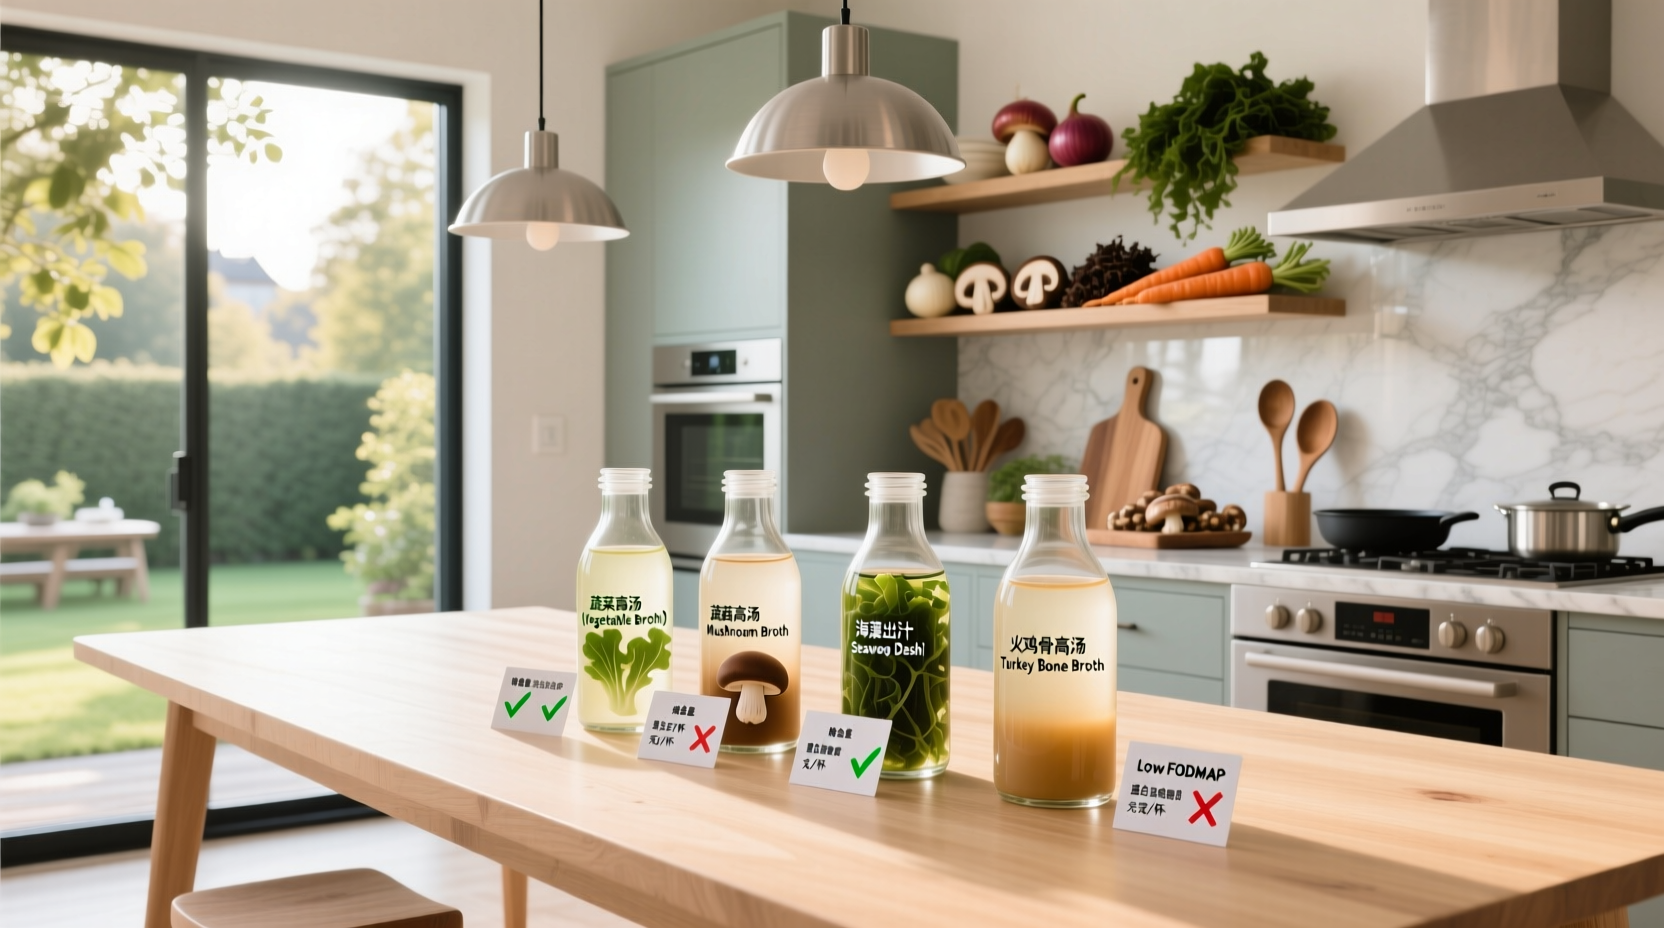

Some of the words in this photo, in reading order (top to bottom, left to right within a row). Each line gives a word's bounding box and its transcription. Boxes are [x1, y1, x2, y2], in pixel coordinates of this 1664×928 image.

[761, 624, 789, 637] Broth
[1010, 635, 1086, 655] 火鸡骨高汤
[1000, 656, 1034, 675] Turkey
[1037, 658, 1068, 672] Bone
[1071, 658, 1105, 672] Broth
[1137, 758, 1165, 775] Low
[1166, 761, 1227, 782] FODMAP
